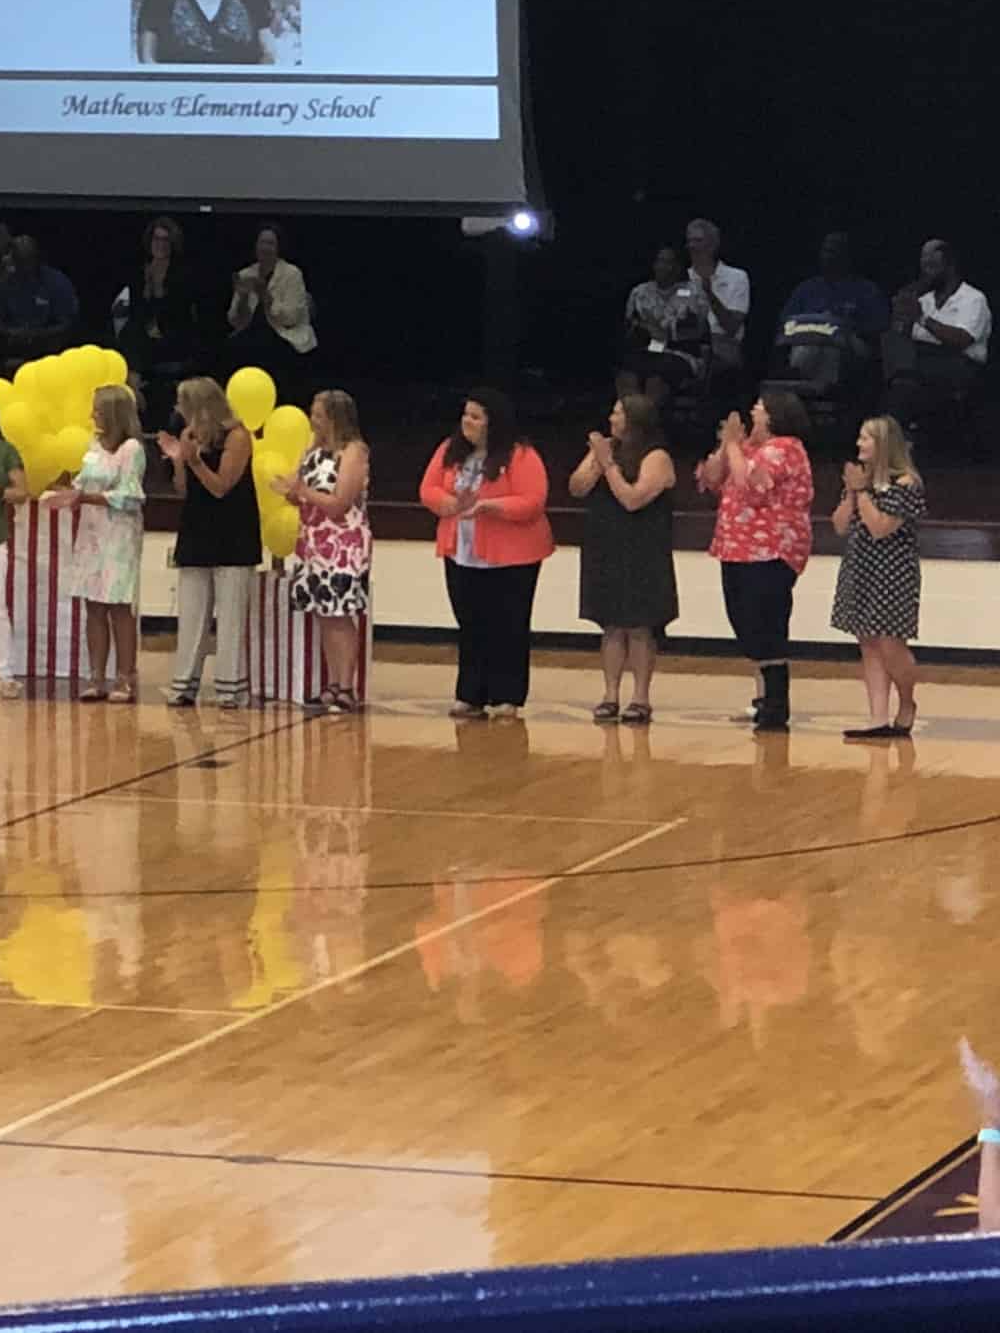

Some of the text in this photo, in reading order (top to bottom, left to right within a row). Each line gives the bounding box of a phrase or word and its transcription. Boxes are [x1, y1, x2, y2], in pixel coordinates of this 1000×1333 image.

[61, 93, 382, 125] Mathews Elementary School
